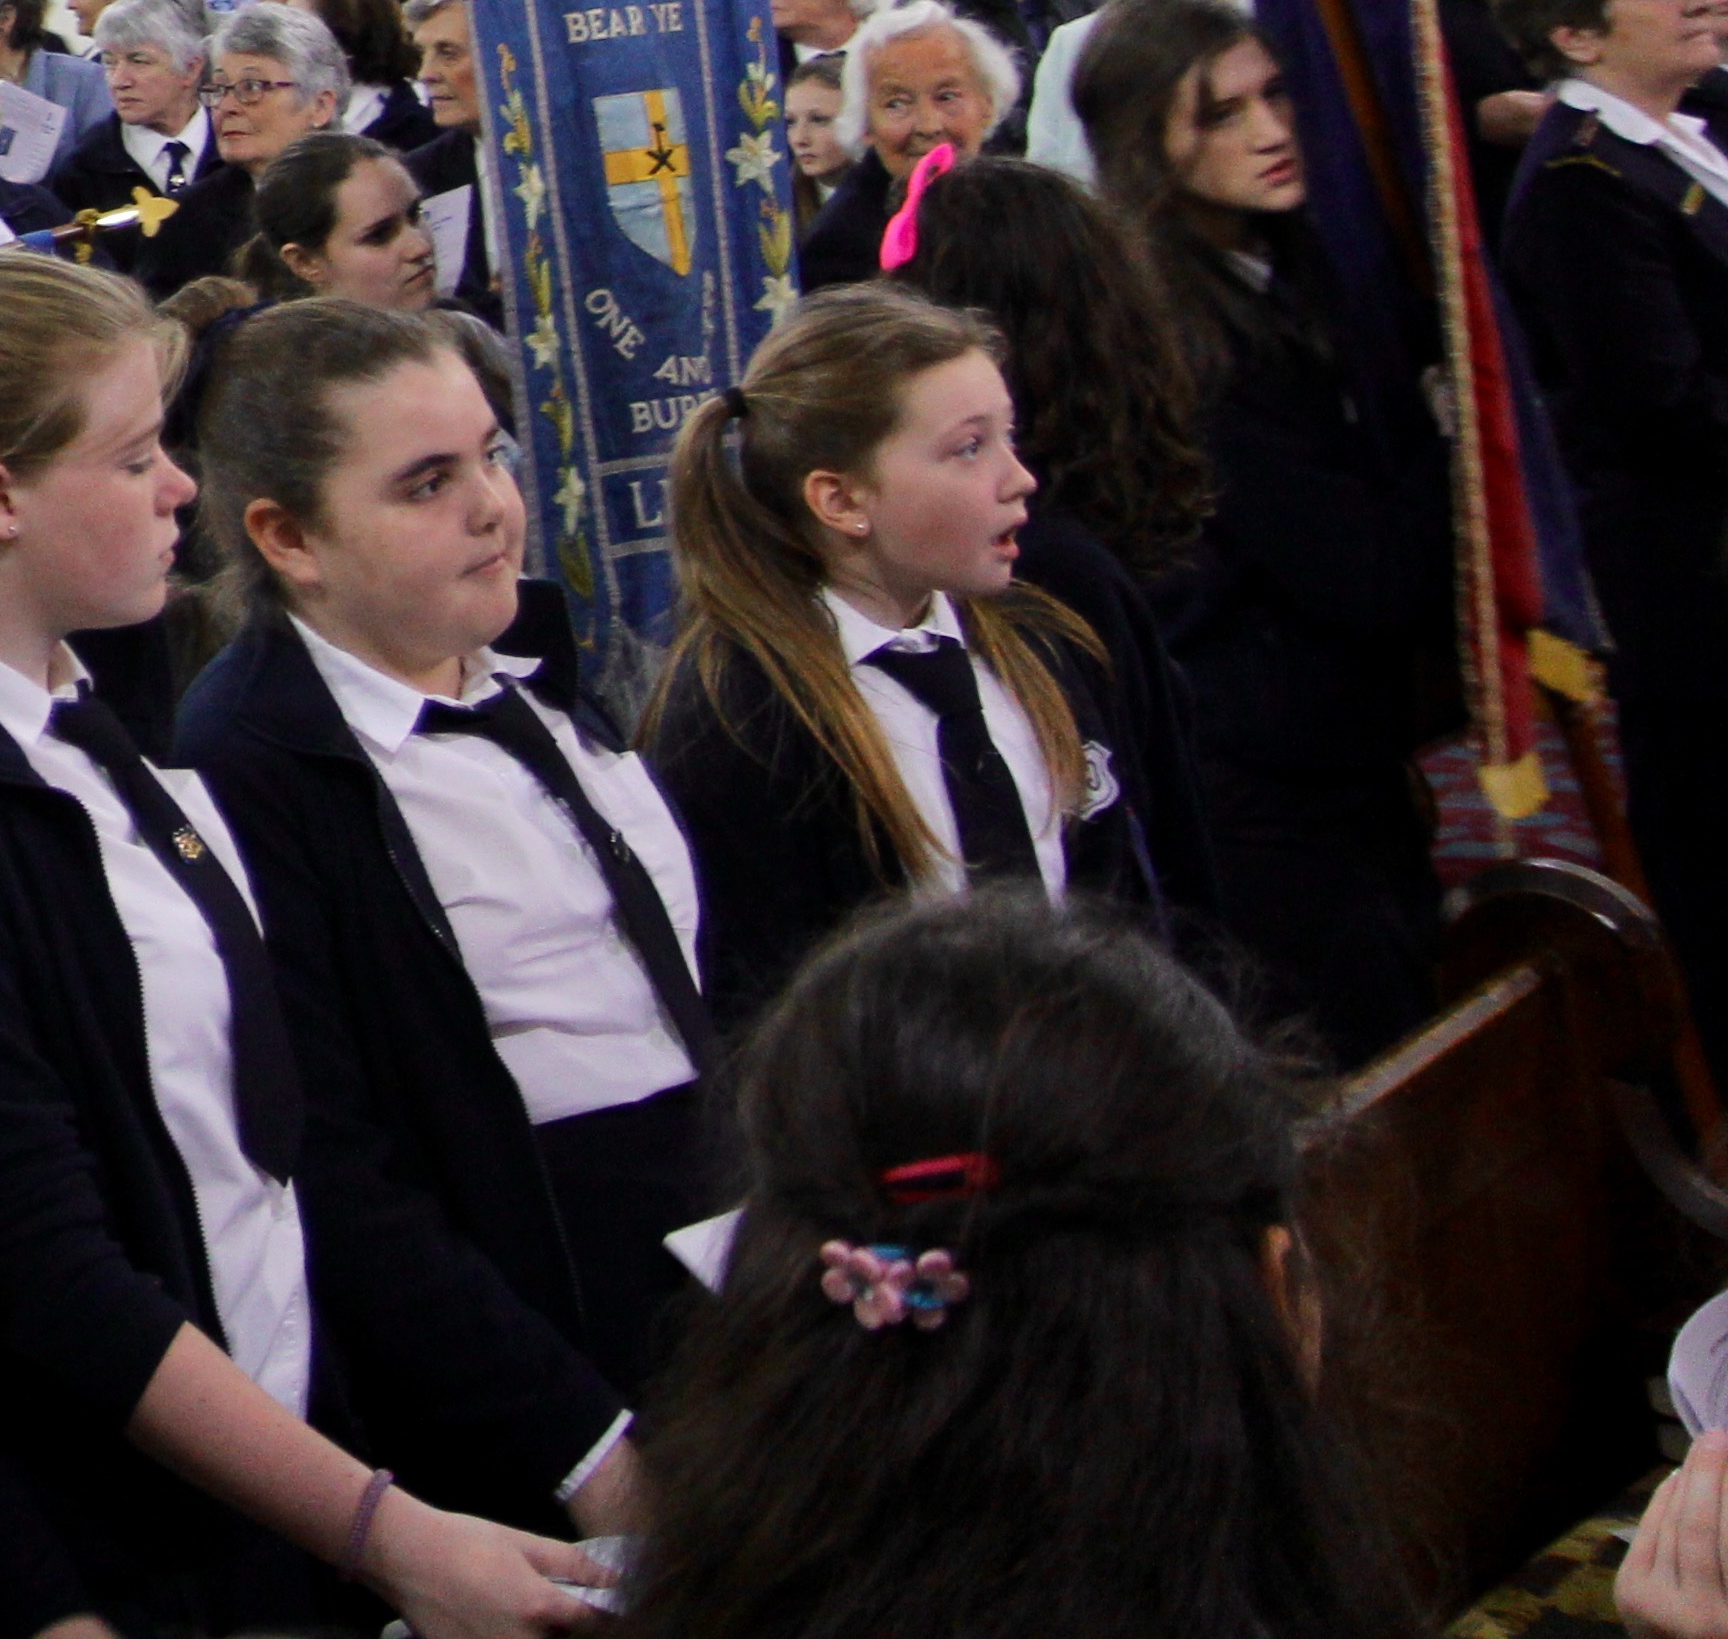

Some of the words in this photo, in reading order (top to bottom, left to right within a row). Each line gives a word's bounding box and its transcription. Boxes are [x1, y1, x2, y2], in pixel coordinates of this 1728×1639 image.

[563, 5, 647, 44] BEAR
[648, 2, 684, 33] YE
[584, 288, 646, 360] ONE
